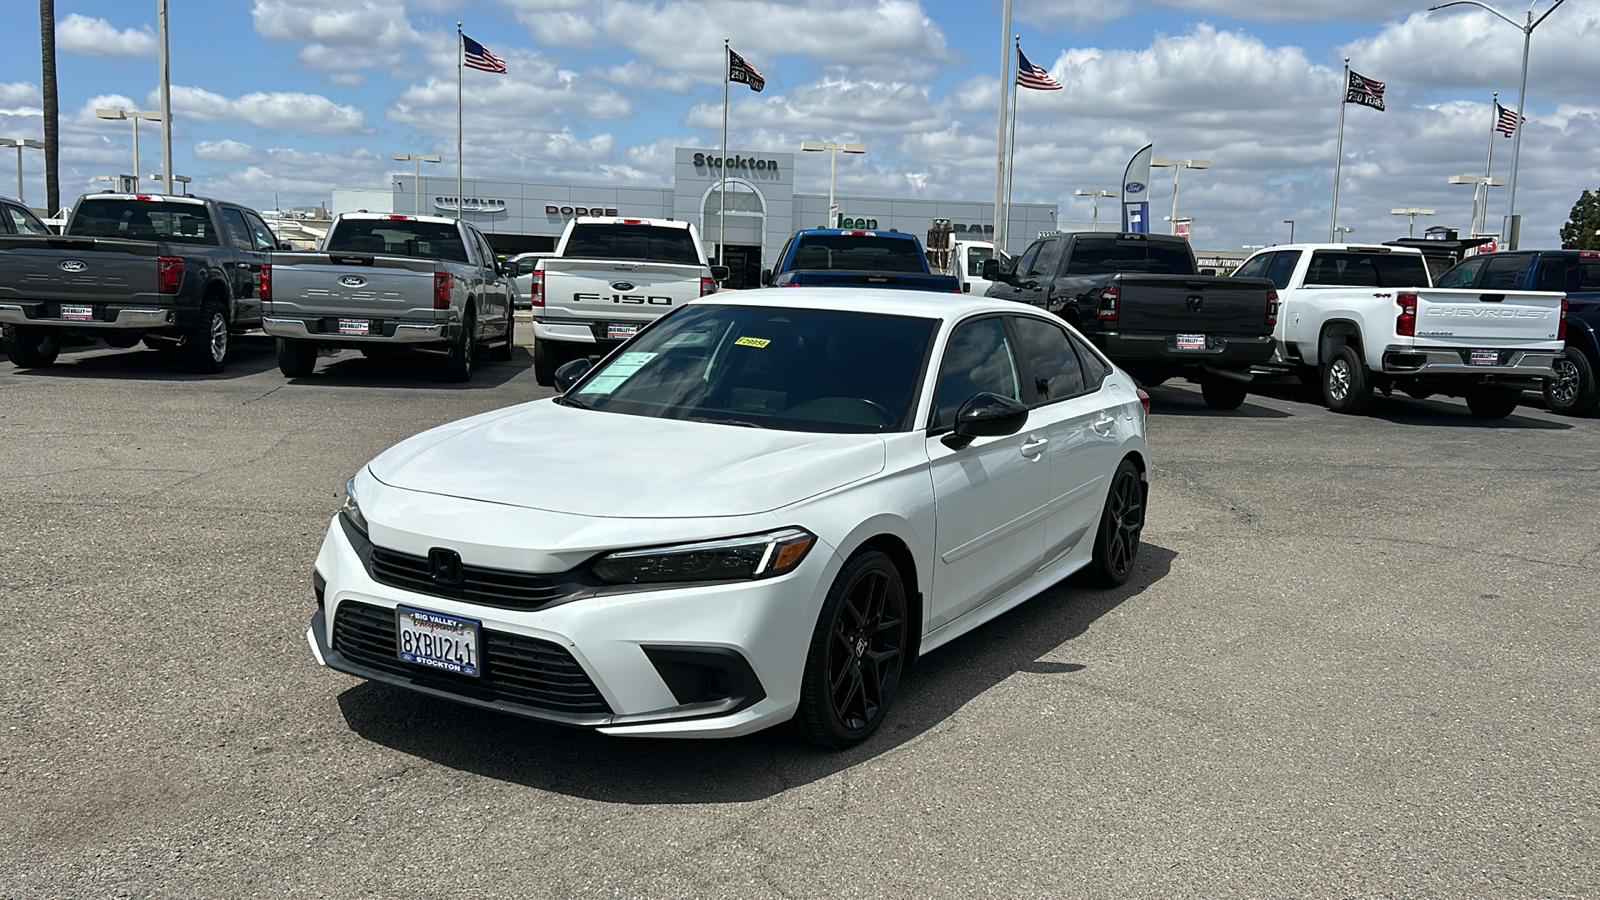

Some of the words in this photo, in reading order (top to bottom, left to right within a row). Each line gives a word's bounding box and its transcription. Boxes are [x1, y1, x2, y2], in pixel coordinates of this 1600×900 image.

[693, 152, 778, 171] Stockton
[545, 205, 618, 217] DODGE
[837, 212, 878, 230] Jeep
[573, 293, 673, 305] F-150
[1426, 306, 1553, 320] CHEVROLET
[414, 612, 428, 621] BIG
[429, 615, 458, 627] VALLEY
[402, 629, 475, 667] 8XBU241
[416, 656, 461, 672] STOCKTON
